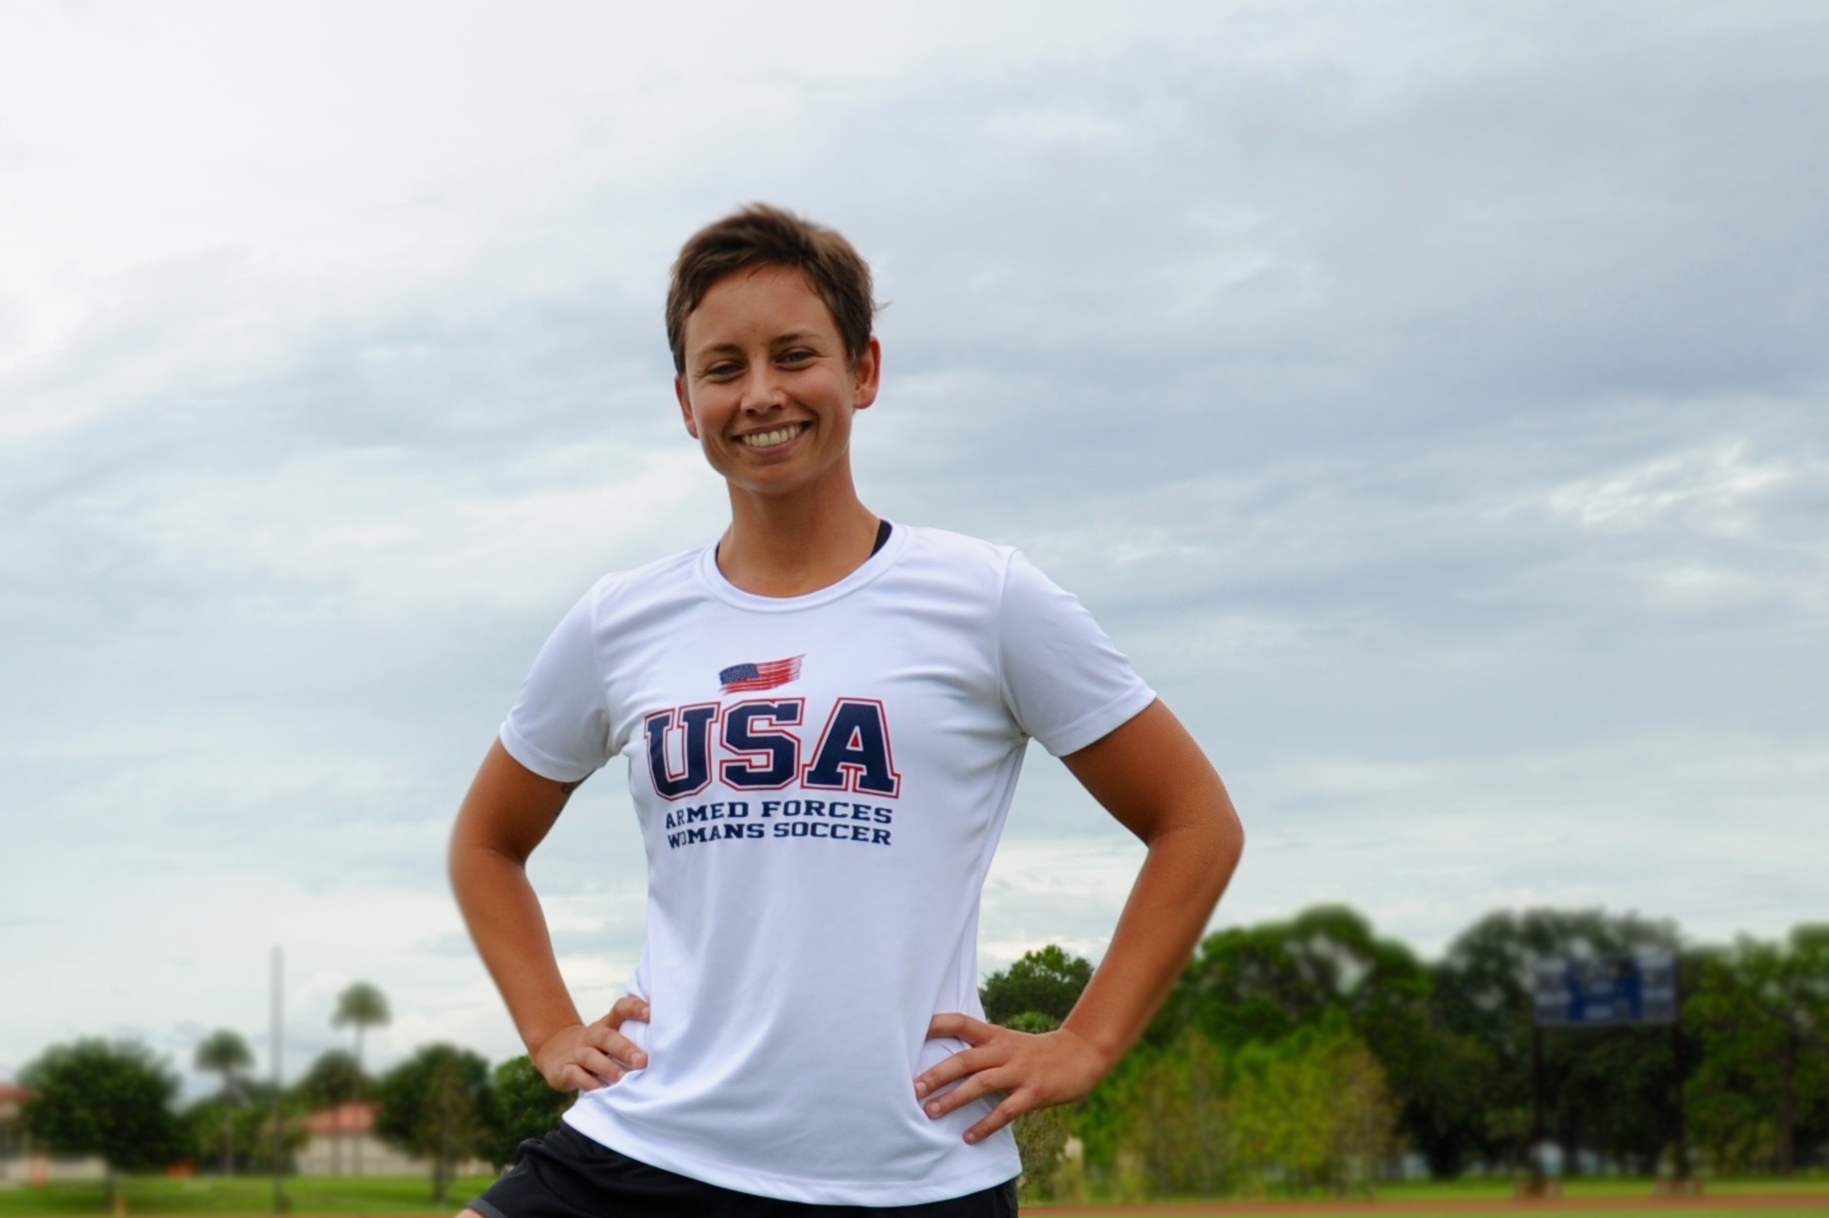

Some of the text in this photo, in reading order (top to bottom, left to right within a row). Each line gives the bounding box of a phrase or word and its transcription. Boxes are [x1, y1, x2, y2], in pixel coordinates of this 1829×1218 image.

[644, 697, 901, 801] USA
[665, 800, 893, 829] ARMED FORCES
[667, 821, 892, 849] WOMANS SOCCER
